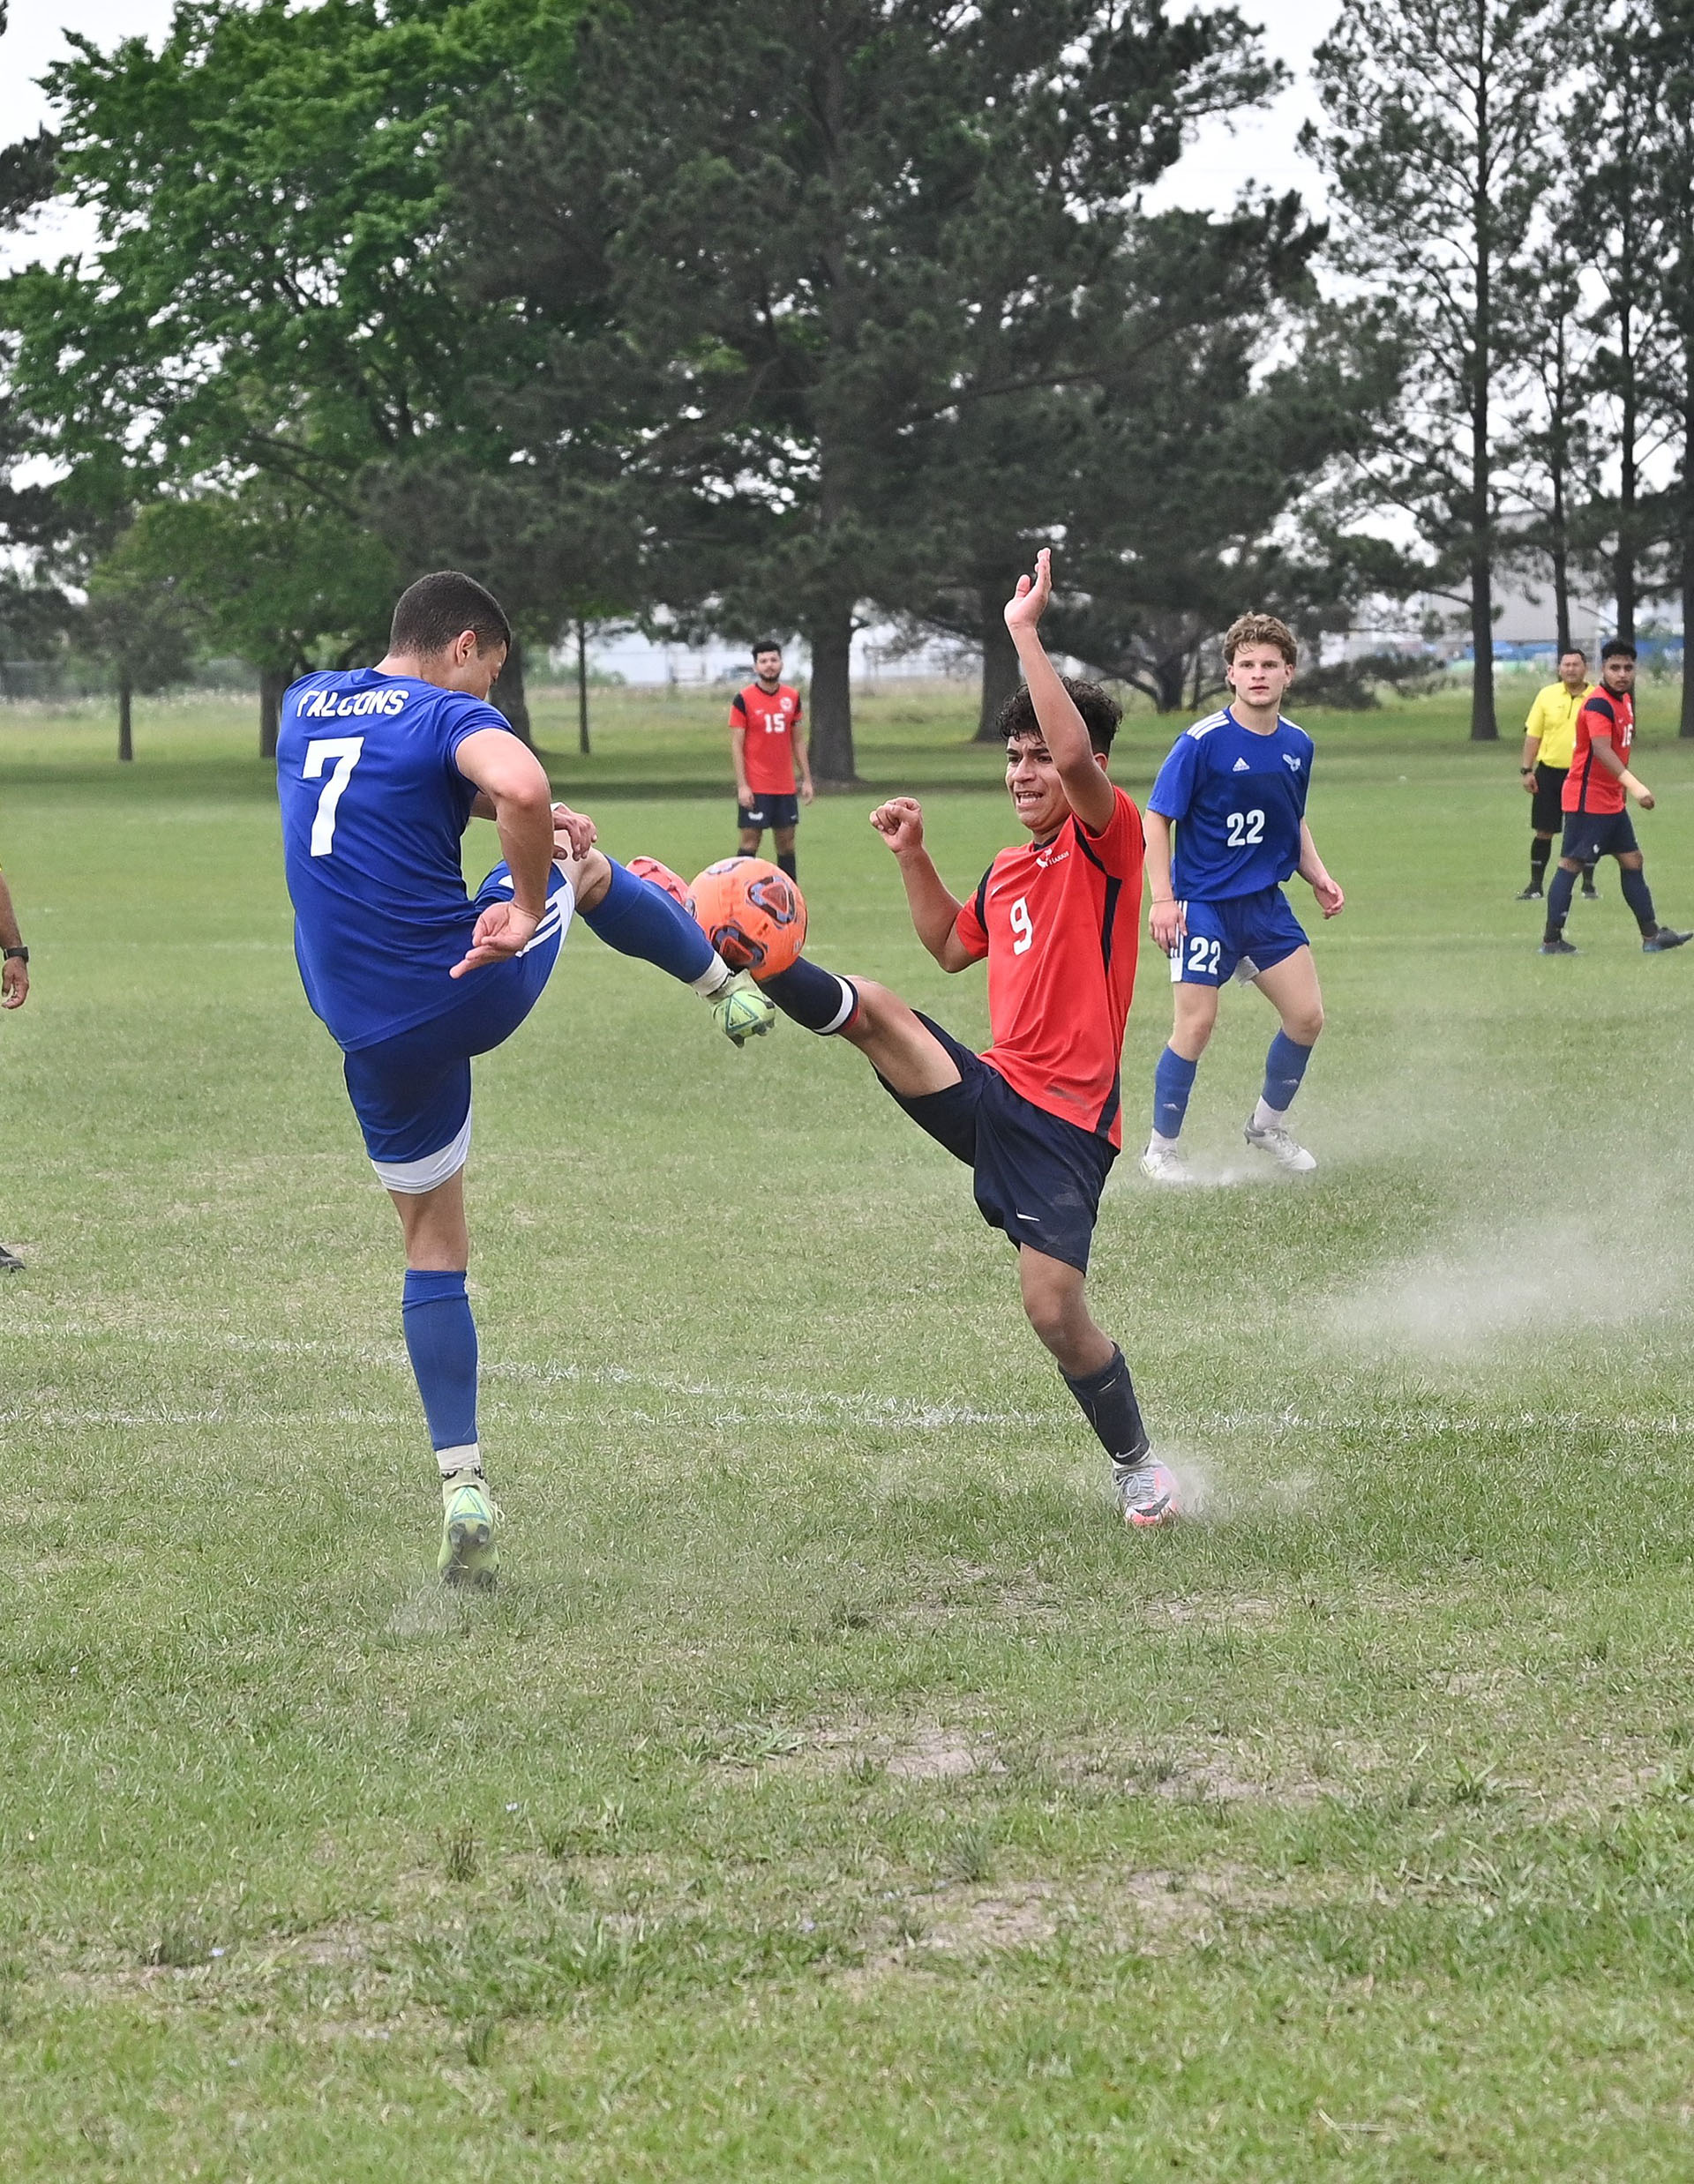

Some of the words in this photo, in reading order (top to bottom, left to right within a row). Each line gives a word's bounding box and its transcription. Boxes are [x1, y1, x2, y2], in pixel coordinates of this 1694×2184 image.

[296, 689, 409, 717] FALCONS
[764, 713, 785, 733] 15
[302, 737, 364, 856] 7
[1226, 809, 1265, 847] 22
[1009, 896, 1033, 956] 9
[1188, 937, 1221, 975] 22
